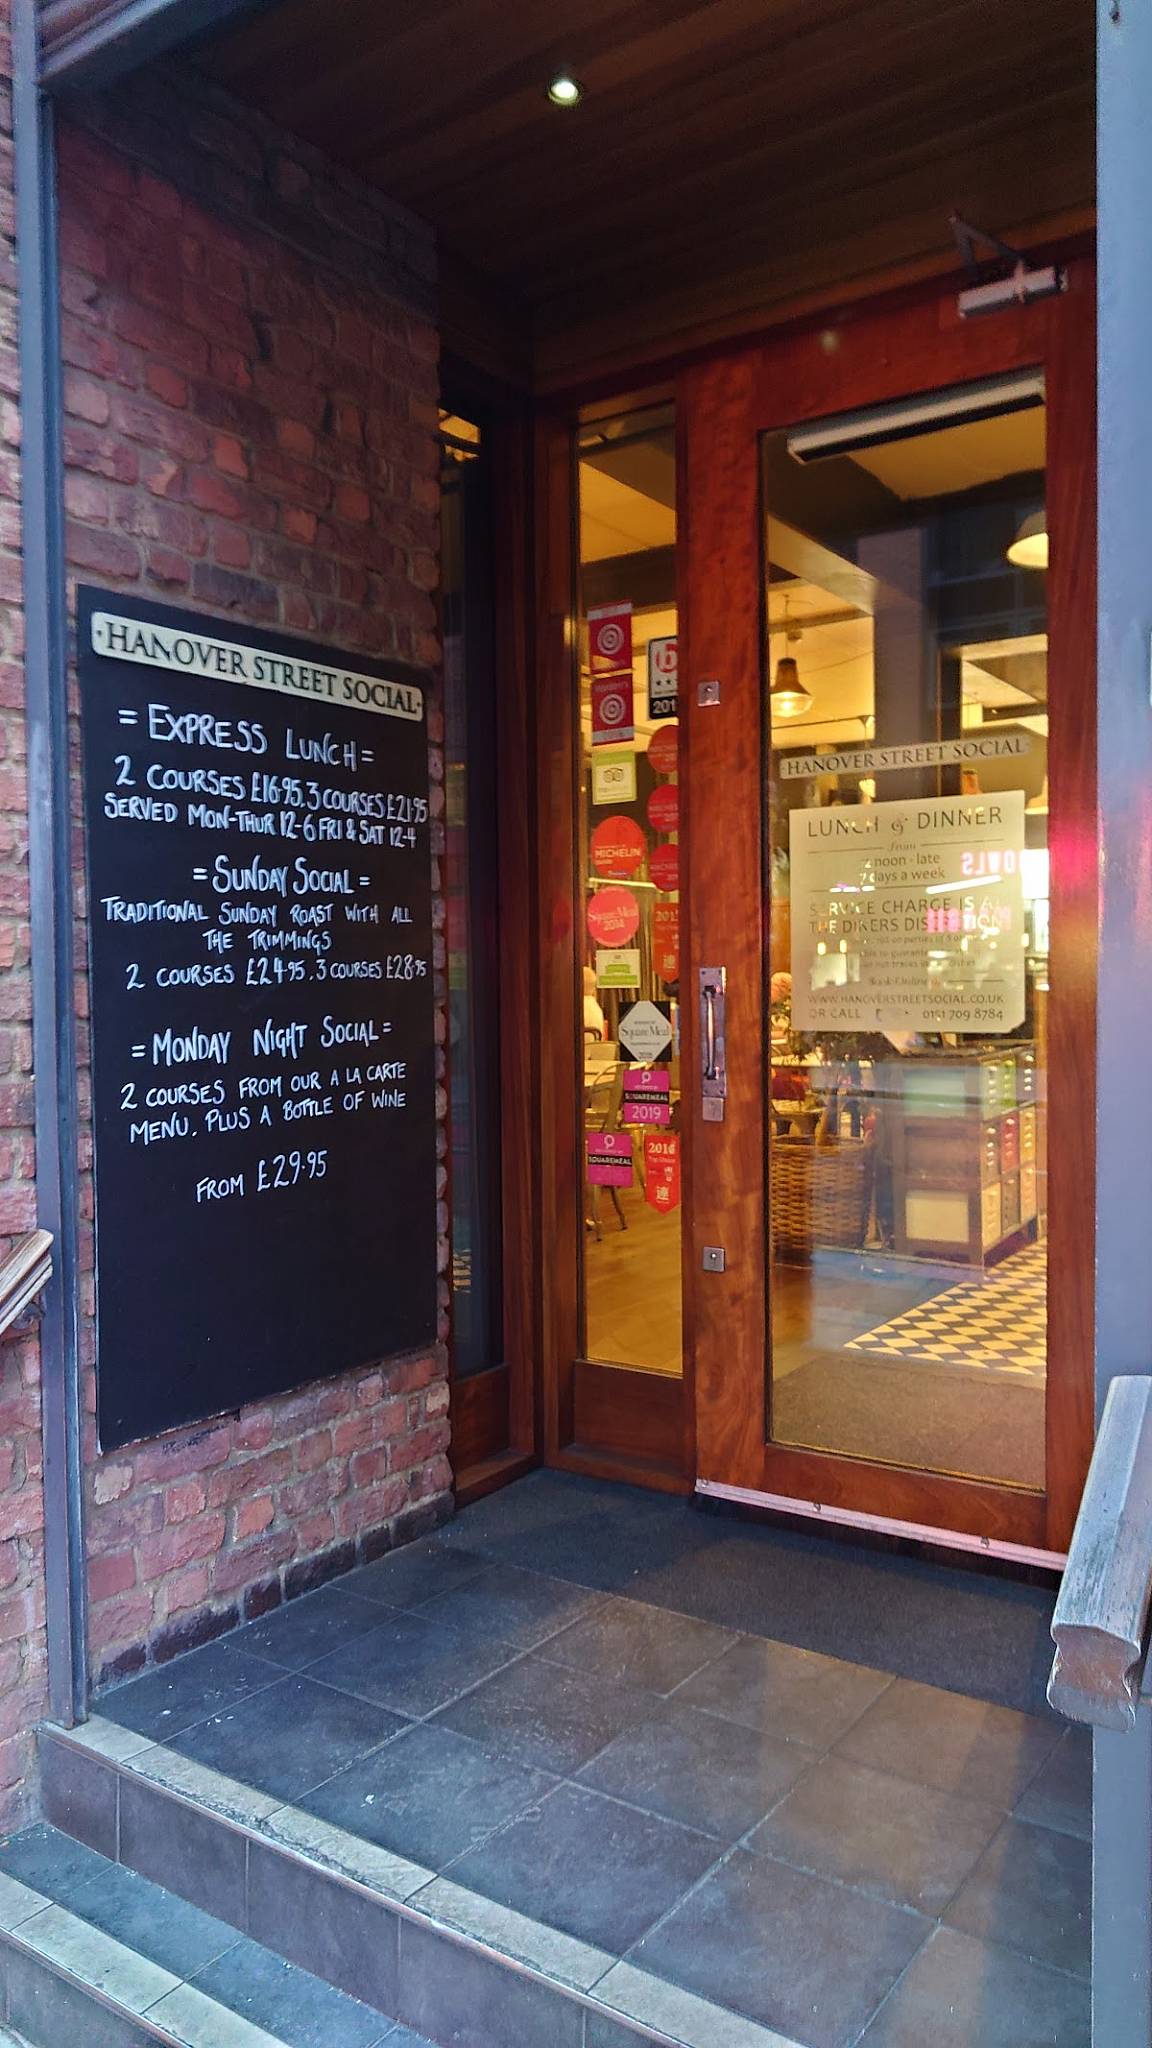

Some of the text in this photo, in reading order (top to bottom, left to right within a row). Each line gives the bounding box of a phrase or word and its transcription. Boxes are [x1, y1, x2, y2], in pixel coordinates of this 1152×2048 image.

[105, 621, 418, 714] HANOVER STREET SOCIAL
[148, 703, 268, 755] EXPRESS
[787, 738, 1024, 775] HANOVER STREET SOCIAL
[114, 755, 136, 786] 2
[147, 764, 246, 800] COURSES
[306, 782, 321, 810] 3
[323, 789, 385, 818] COURSES
[104, 792, 416, 848] SERVED MON-THUR 12-6 FRI & SAT 12-4
[917, 806, 1003, 830] DINNER
[594, 848, 641, 858] MICHELIN
[874, 856, 906, 867] noon
[916, 853, 940, 865] late
[212, 855, 354, 898] SUNDAY SOCIAL
[911, 868, 945, 880] week
[101, 896, 413, 926] TRADITIONAL SUNDAY ROAST WITH ALL
[882, 898, 951, 913] CHARGE
[203, 928, 332, 955] THE TRIMMINGS
[126, 962, 145, 990] 2
[156, 964, 234, 988] COURSES
[316, 959, 326, 980] 3
[330, 961, 382, 979] COURSES
[830, 1007, 861, 1019] CALL
[949, 1008, 971, 1024] 709
[974, 1007, 1004, 1021] 8784
[152, 1015, 380, 1067] MONDAY NIGHT SOCIAL
[120, 1062, 406, 1110] 2 COURSES FROM OUR A LA CARTE
[205, 1107, 250, 1132] PLUS
[260, 1105, 272, 1127] A
[283, 1097, 333, 1121] BOTTLE
[343, 1090, 365, 1110] OF
[371, 1089, 406, 1108] WINE
[632, 1105, 661, 1120] 2019
[196, 1150, 327, 1203] FROM £29.95
